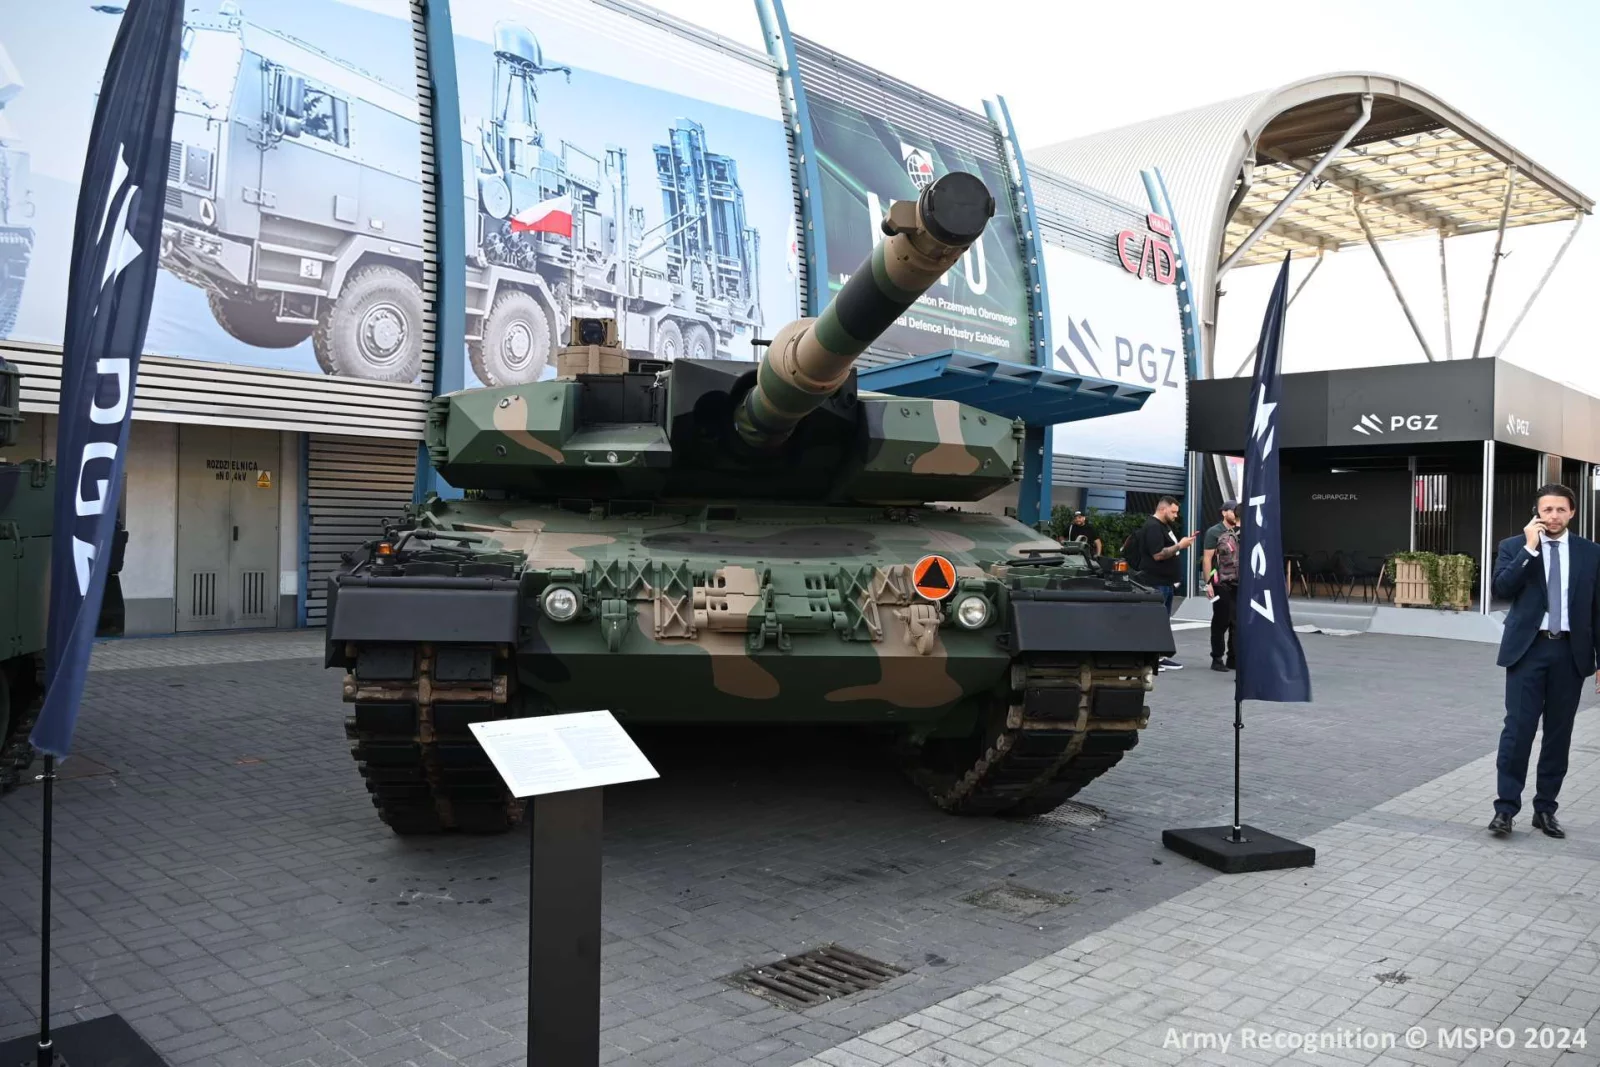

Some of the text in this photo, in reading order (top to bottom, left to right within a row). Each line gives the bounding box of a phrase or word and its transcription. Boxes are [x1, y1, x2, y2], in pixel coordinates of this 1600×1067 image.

[1117, 228, 1176, 285] C/D
[977, 307, 1018, 327] Obronnego
[908, 316, 943, 334] Defence
[943, 324, 975, 343] Industry
[975, 331, 1010, 349] Exhibition
[1115, 335, 1178, 389] PGZ
[1390, 414, 1439, 432] PGZ
[1516, 418, 1530, 436] PGZ
[206, 459, 258, 471] ROZDZIELNICA
[1311, 493, 1358, 501] GRUPAPGZ.PL
